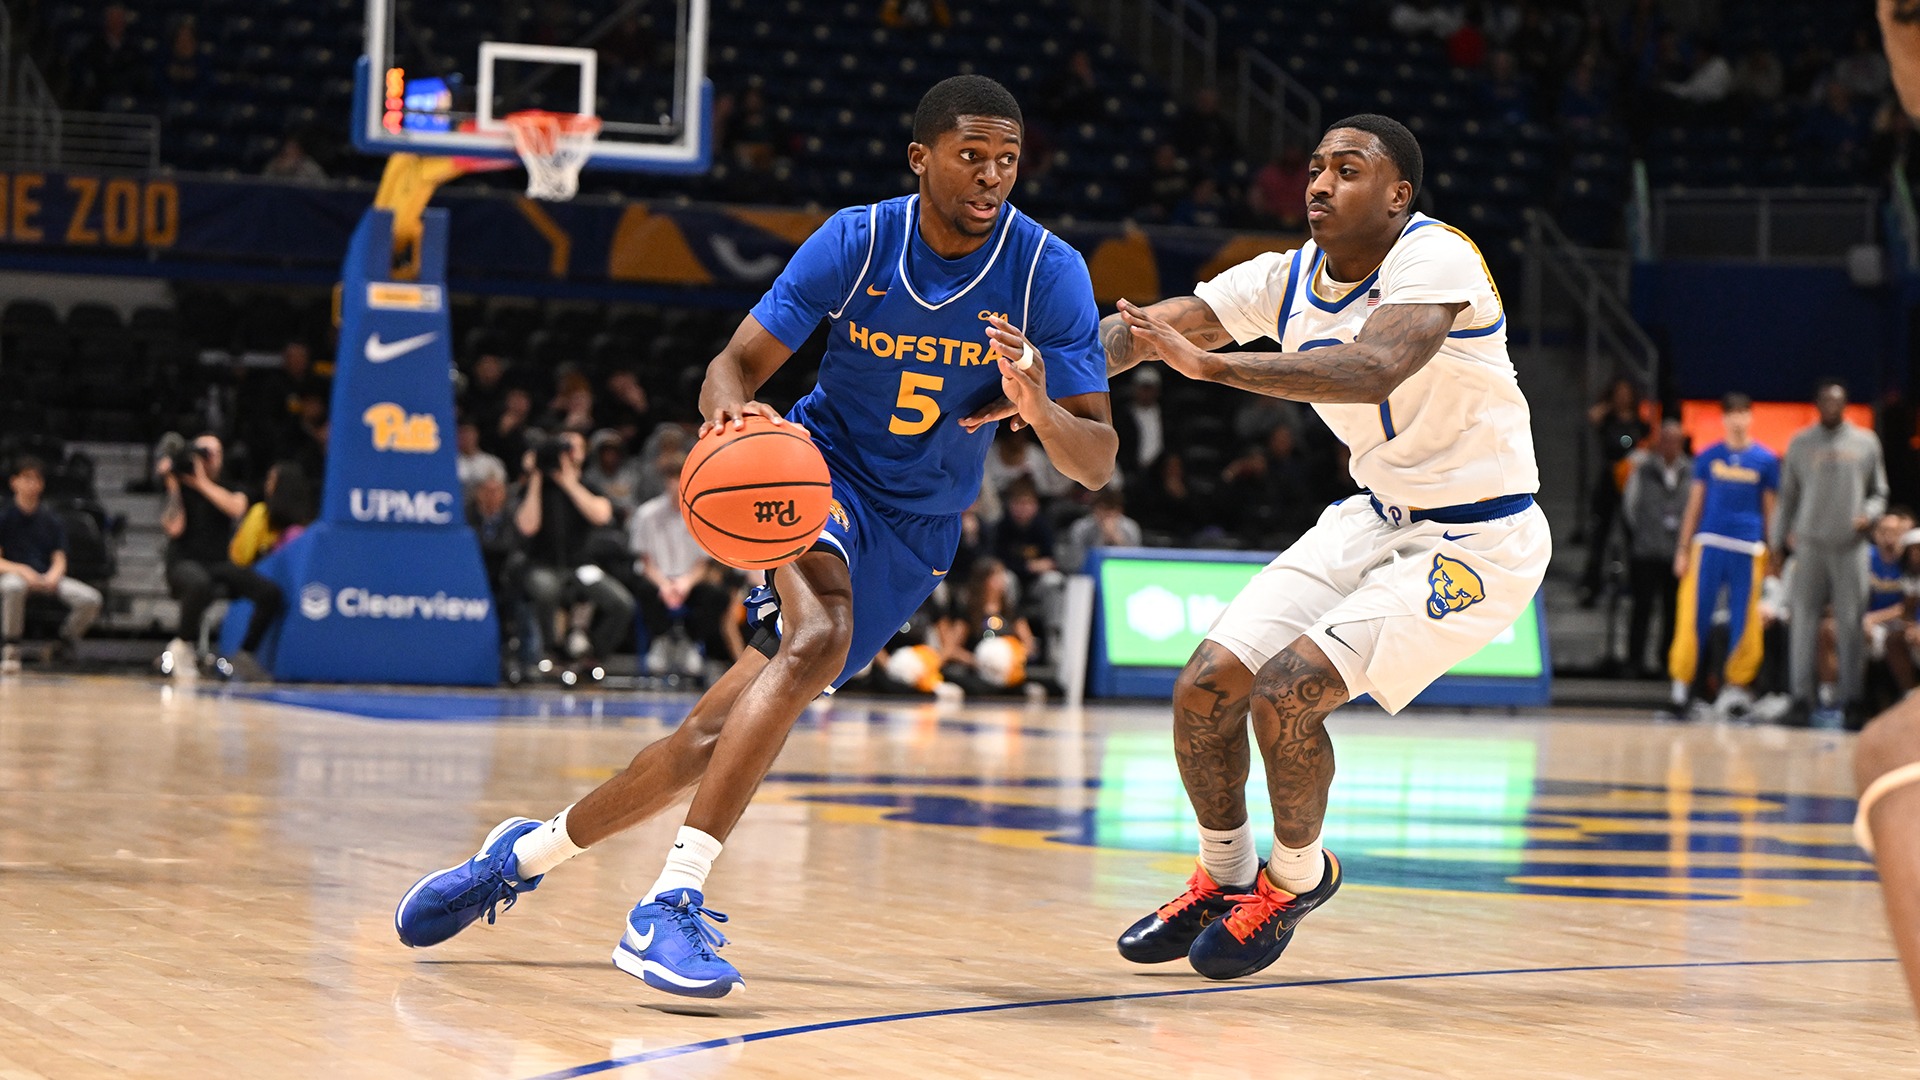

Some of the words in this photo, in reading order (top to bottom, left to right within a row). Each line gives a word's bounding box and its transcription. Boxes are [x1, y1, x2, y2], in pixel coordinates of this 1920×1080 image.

[66, 176, 179, 246] ZOO
[888, 371, 944, 436] 5
[362, 401, 441, 454] Pitt
[349, 488, 453, 525] UPMC
[753, 499, 802, 527] Pitt
[335, 586, 489, 622] Clearview
